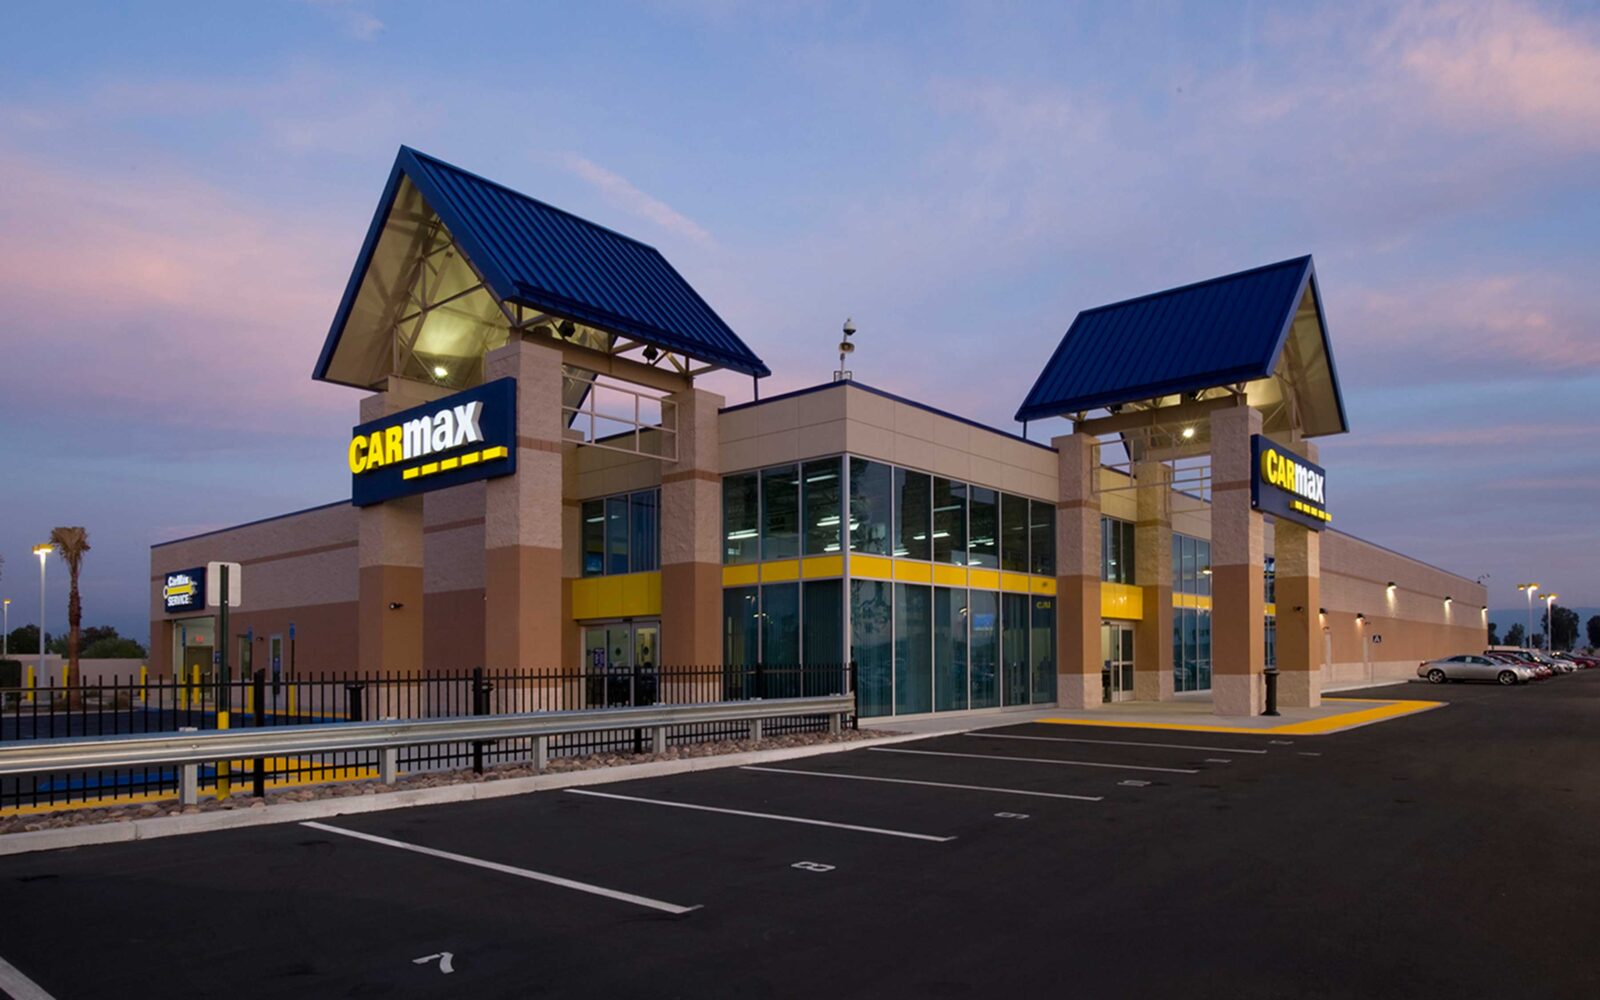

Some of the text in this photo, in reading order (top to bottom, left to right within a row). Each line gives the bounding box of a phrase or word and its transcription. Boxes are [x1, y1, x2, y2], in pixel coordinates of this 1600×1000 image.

[348, 401, 484, 474] CARmax
[1262, 448, 1325, 505] CARmax
[791, 861, 836, 872] 8
[412, 951, 455, 975] 7
